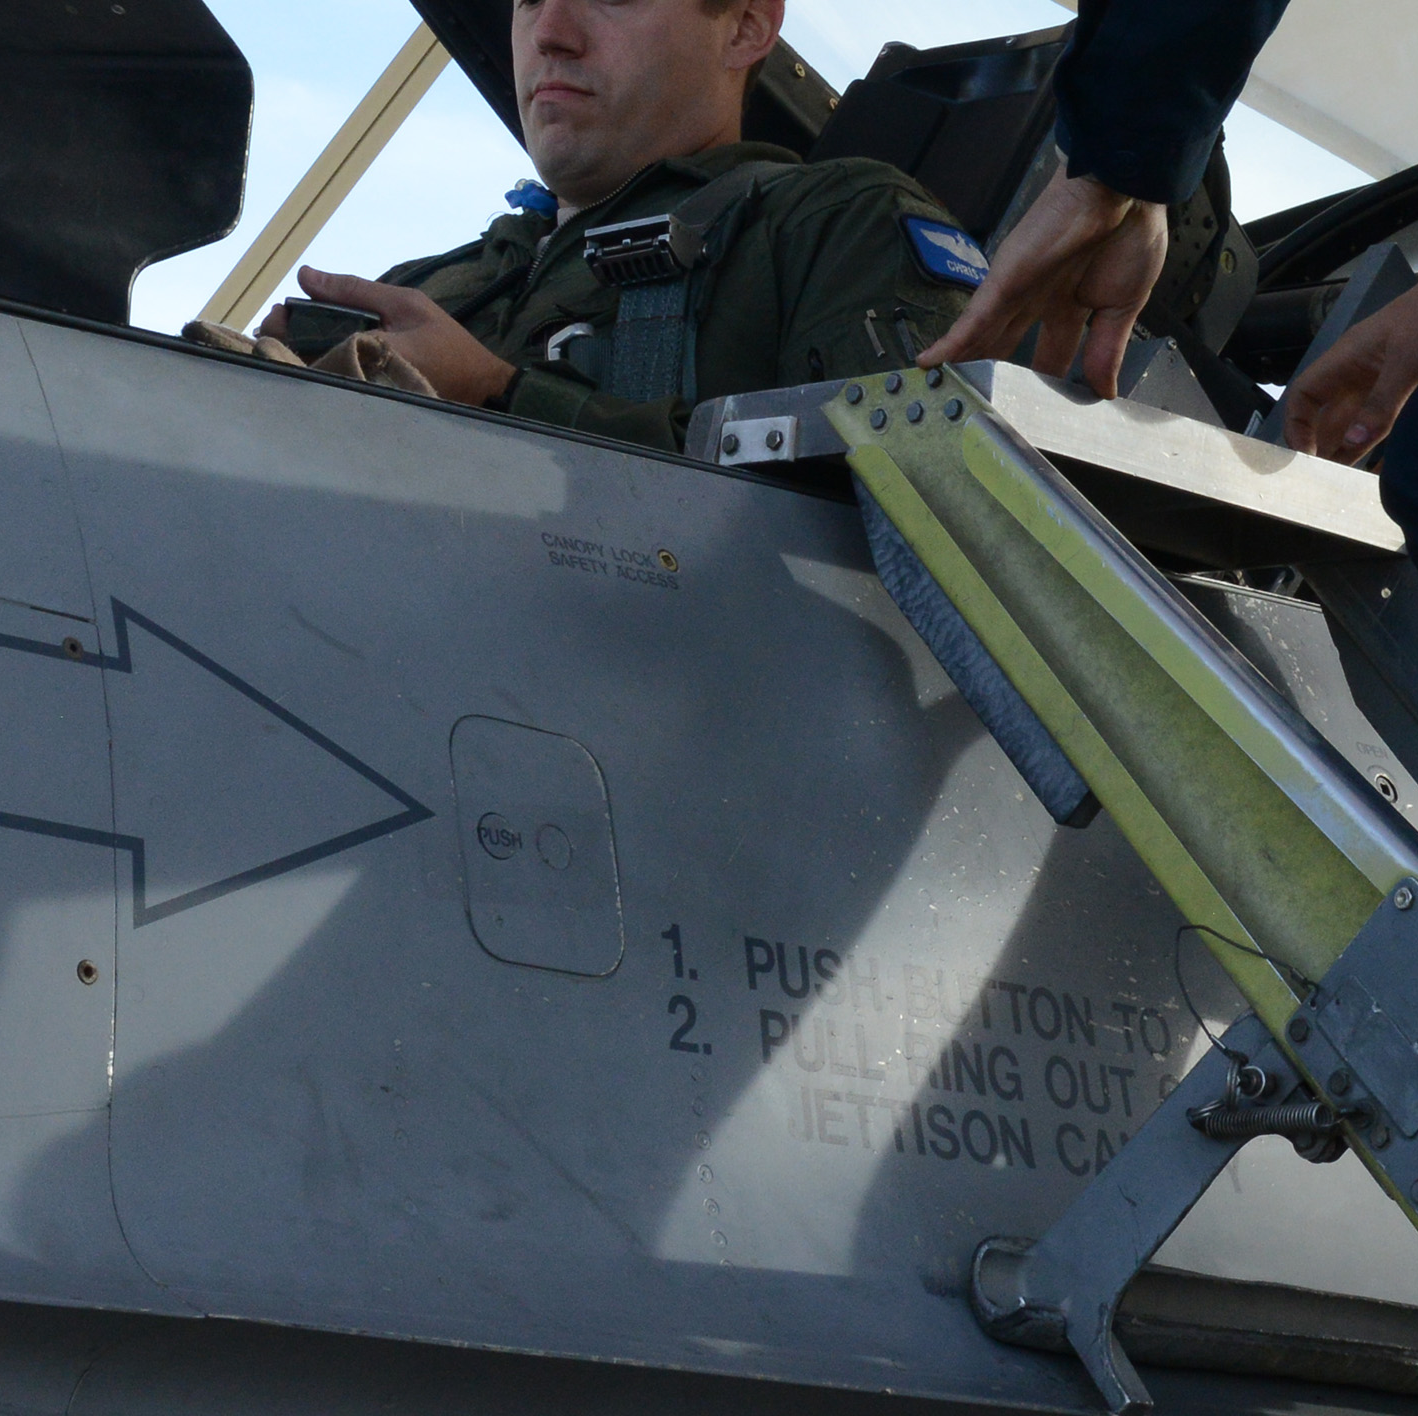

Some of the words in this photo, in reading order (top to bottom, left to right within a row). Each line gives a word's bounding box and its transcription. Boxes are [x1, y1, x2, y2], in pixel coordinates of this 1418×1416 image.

[946, 259, 979, 280] CHRIS
[541, 532, 604, 557] CANOPY
[610, 546, 656, 568] LOCK
[548, 551, 607, 574] SAFETY
[617, 565, 679, 590] ACCESS
[479, 827, 523, 849] PUSH
[661, 923, 699, 981] 1.
[744, 936, 882, 1012] PUSH
[903, 962, 1096, 1047] BUTTON
[1111, 1001, 1171, 1058] TO
[667, 994, 713, 1055] 2.
[759, 1009, 886, 1081] PULL
[904, 1026, 1024, 1101] RING
[1044, 1055, 1136, 1117] OUT
[788, 1084, 1036, 1169] JETTISON
